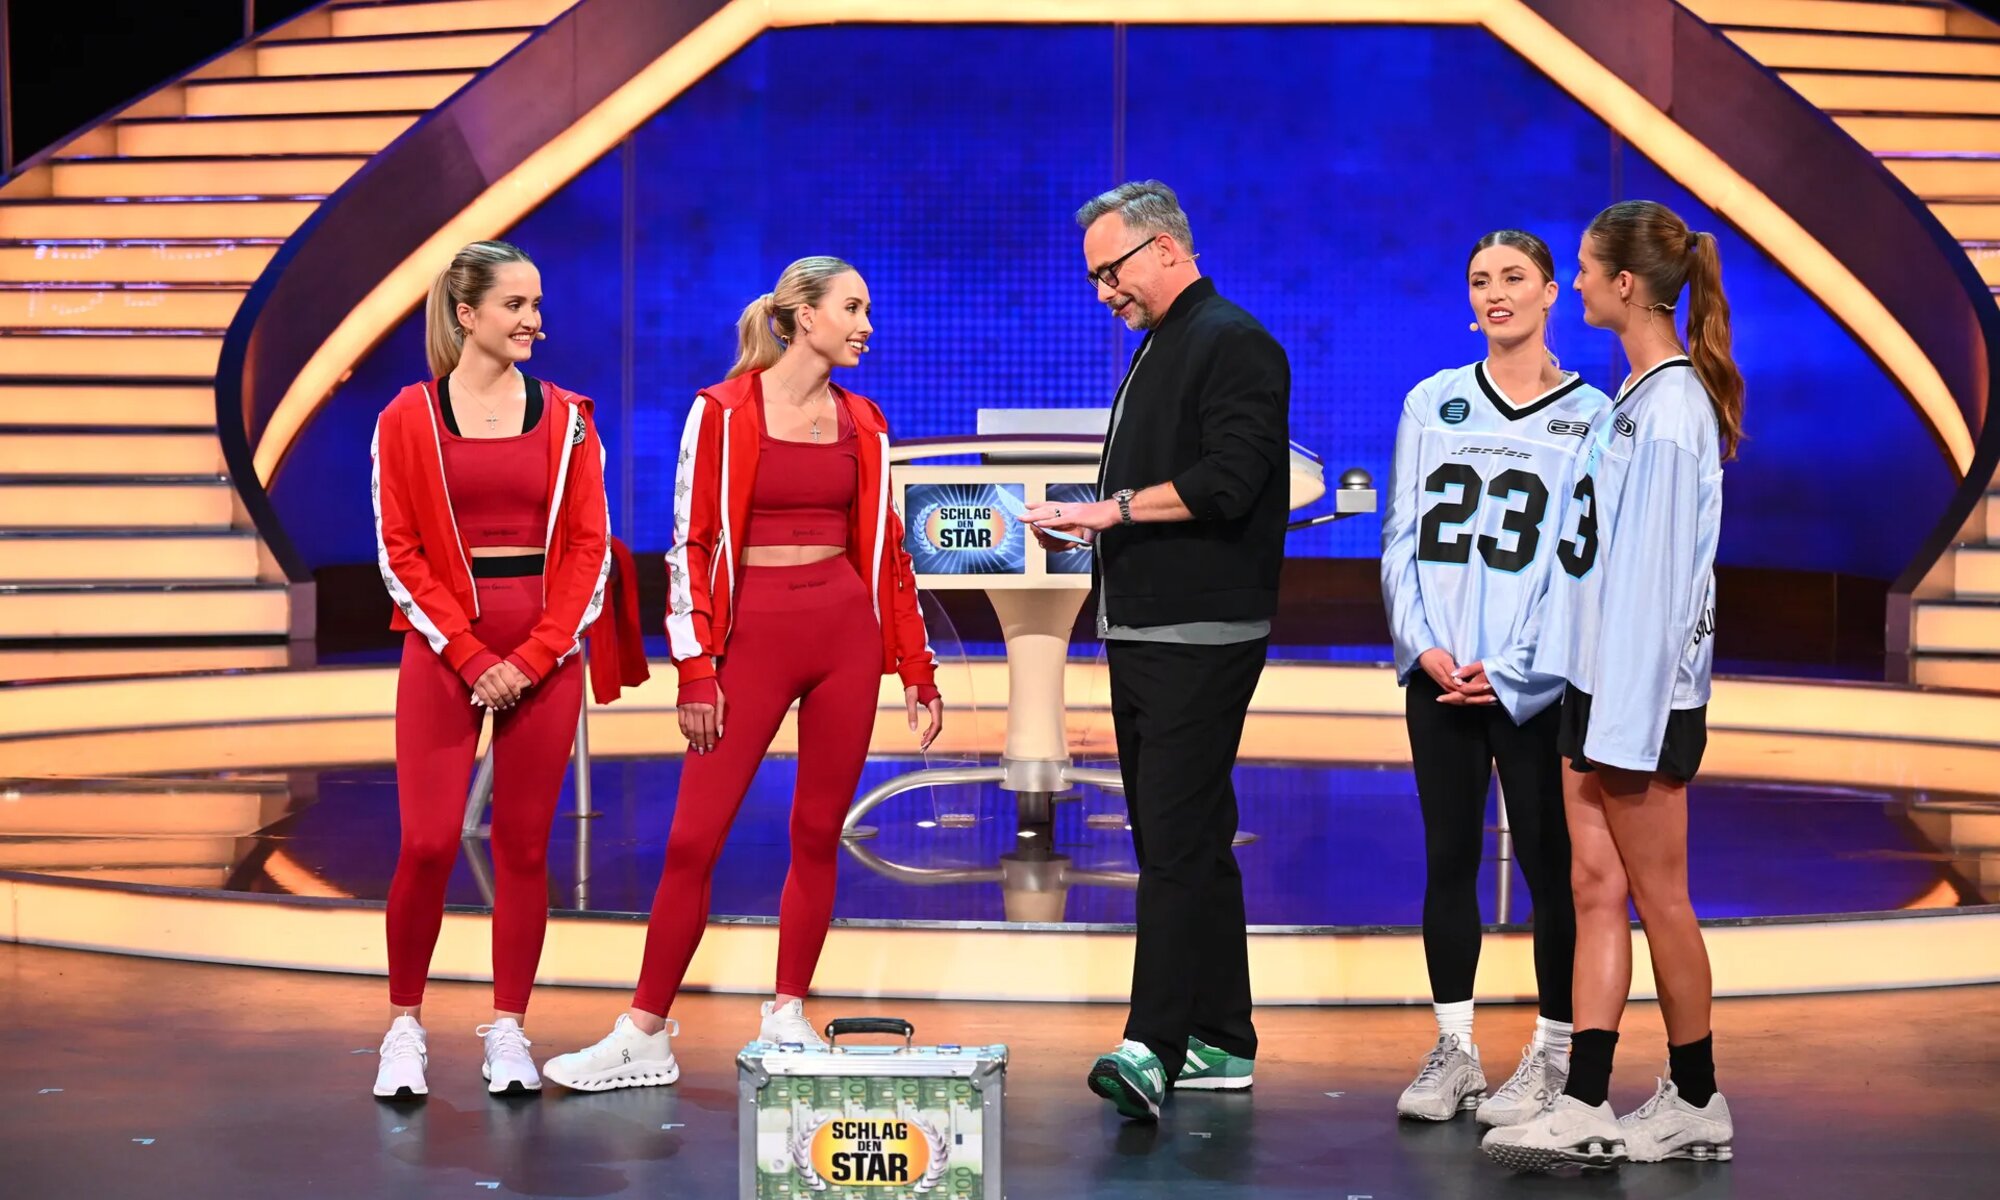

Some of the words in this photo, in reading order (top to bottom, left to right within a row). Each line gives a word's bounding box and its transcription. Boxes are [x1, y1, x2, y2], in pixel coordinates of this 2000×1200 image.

[940, 507, 991, 520] SCHLAG
[1418, 463, 1549, 573] 23
[957, 520, 974, 528] DEN
[940, 528, 991, 548] STAR
[832, 1121, 908, 1140] SCHLAG
[857, 1140, 882, 1152] DEN
[832, 1152, 908, 1182] STAR
